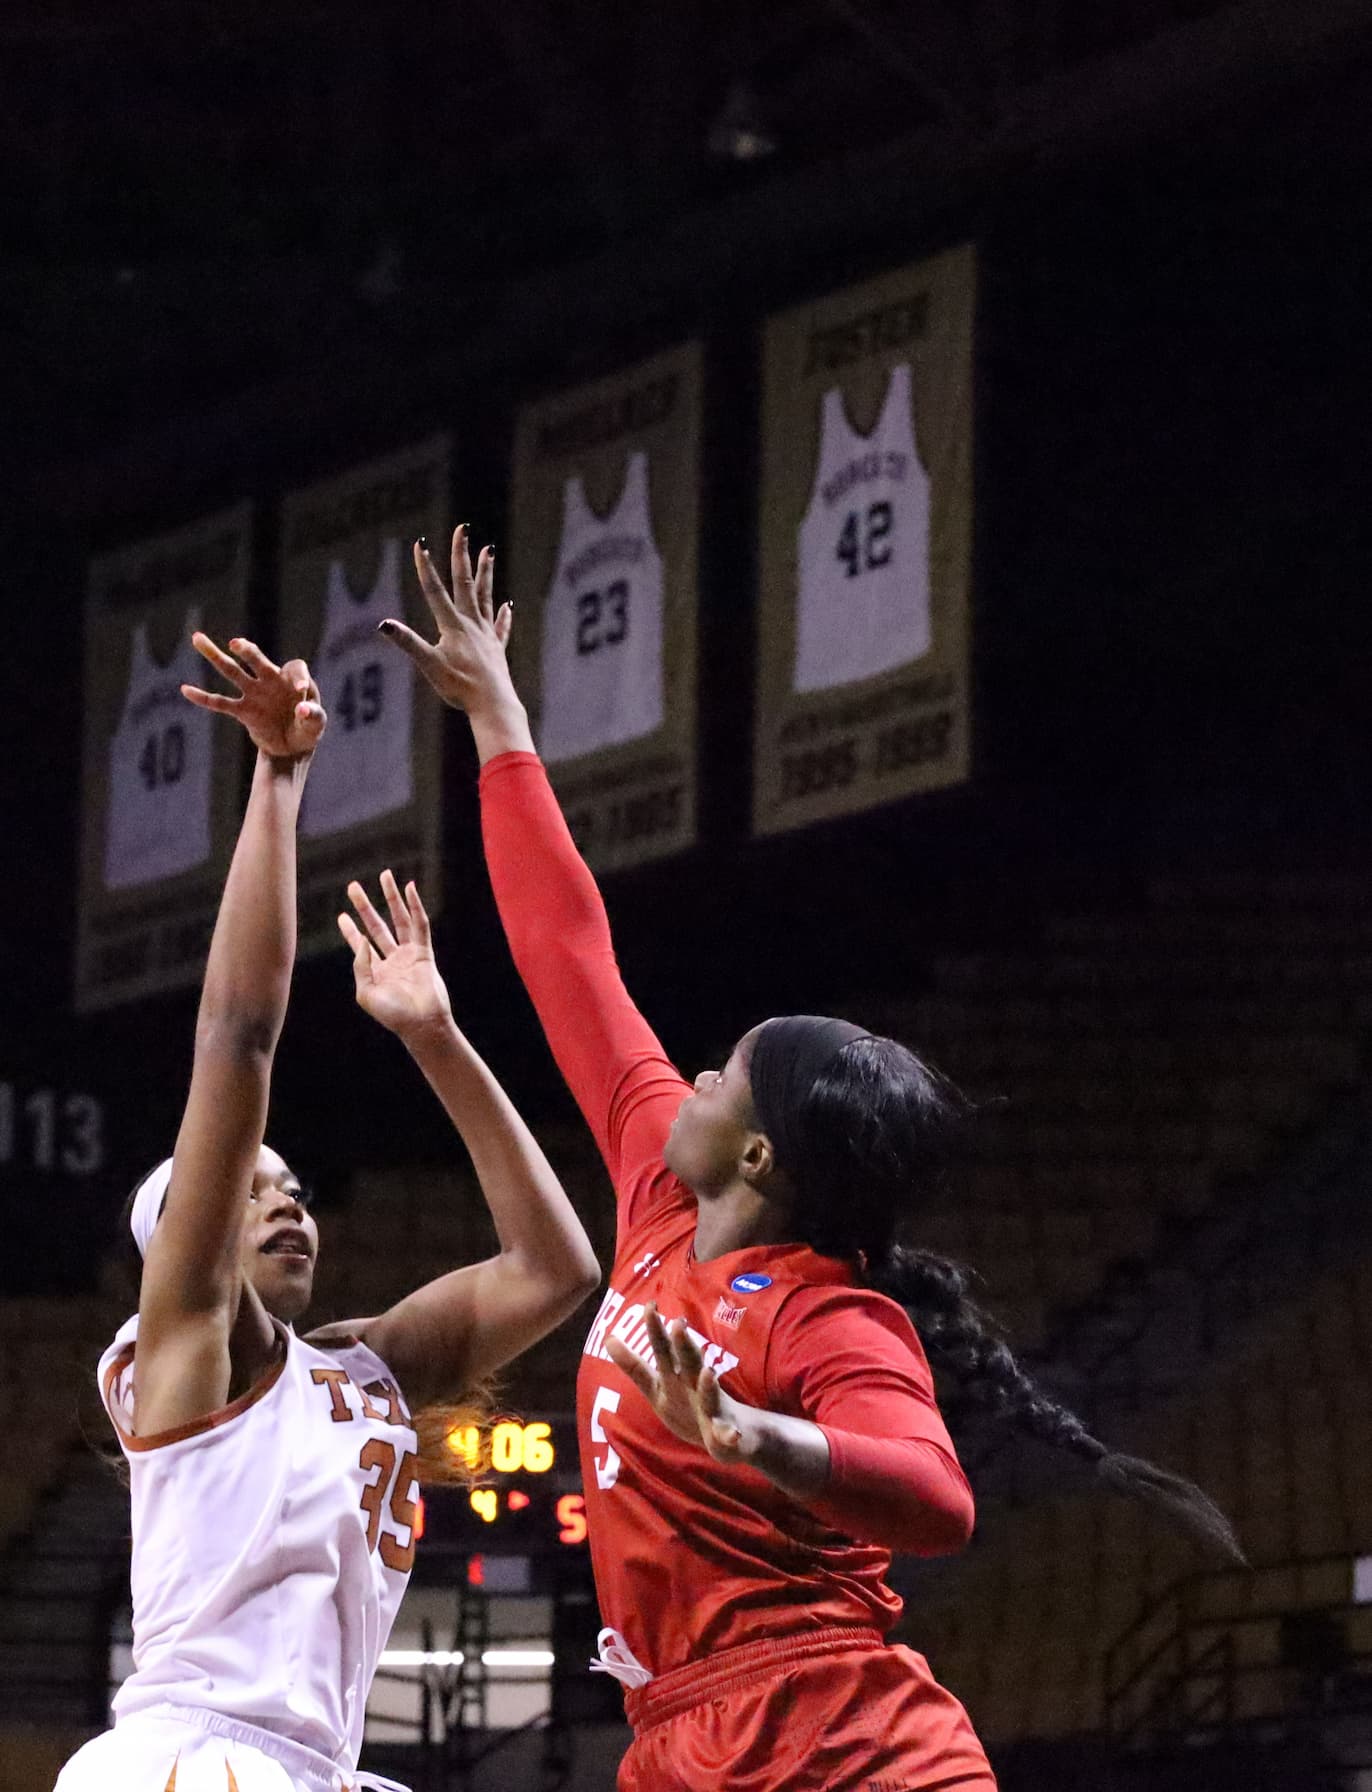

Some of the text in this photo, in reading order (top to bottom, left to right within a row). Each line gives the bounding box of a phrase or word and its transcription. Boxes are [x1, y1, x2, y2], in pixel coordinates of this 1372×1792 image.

[836, 502, 893, 578] 42
[578, 580, 629, 656] 23
[138, 721, 185, 791] 40
[591, 1385, 621, 1490] 5
[360, 1438, 419, 1573] 35
